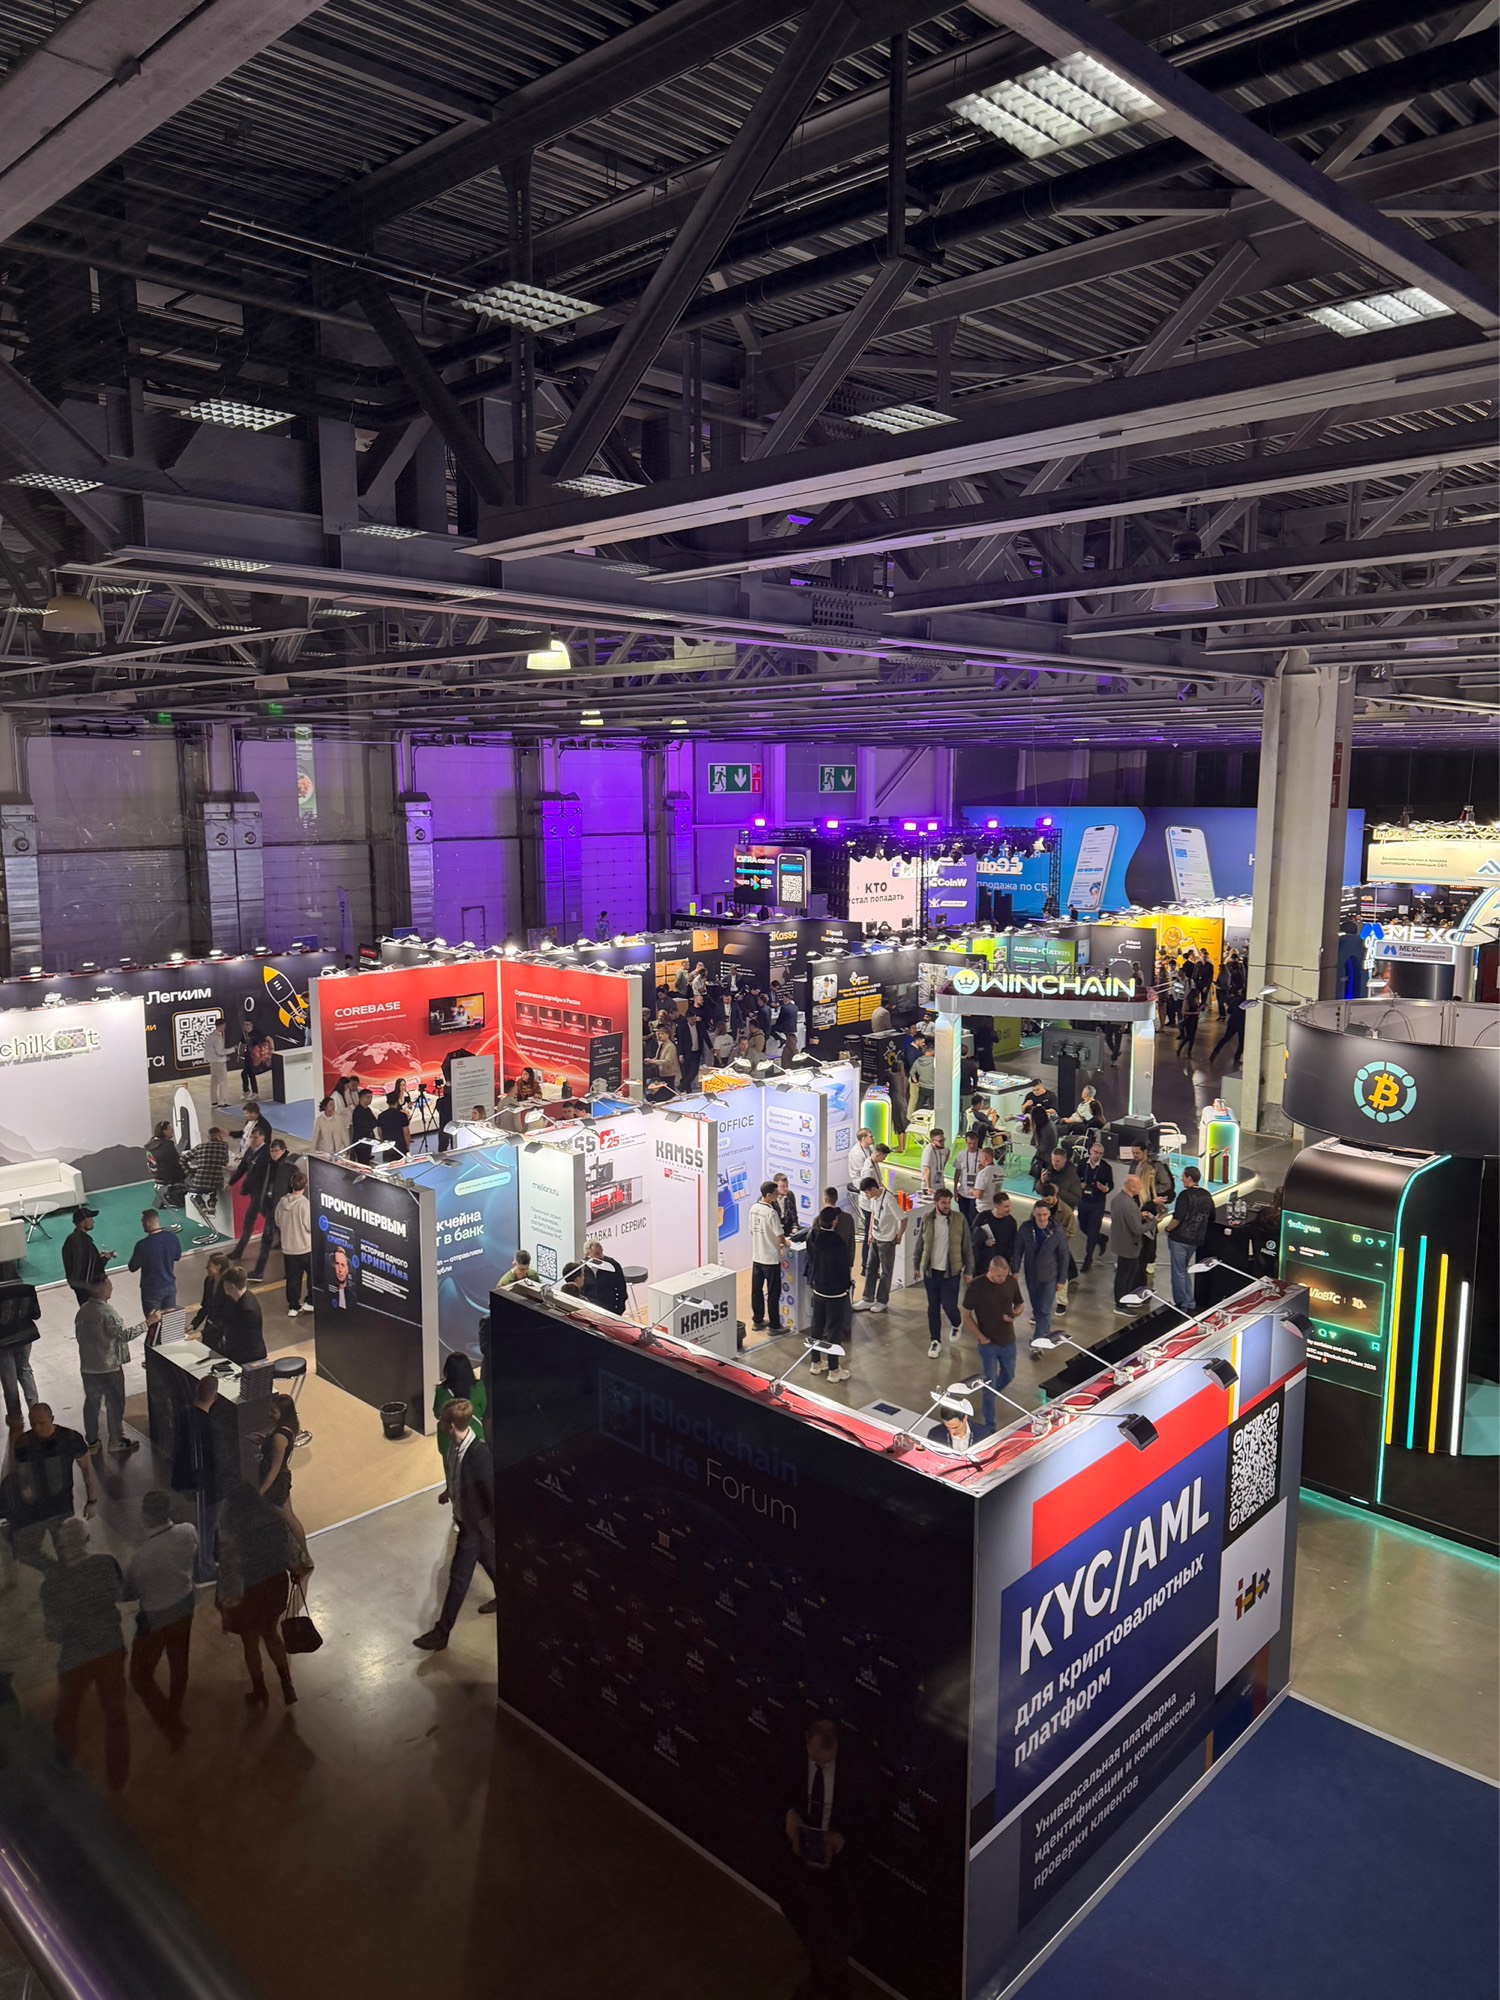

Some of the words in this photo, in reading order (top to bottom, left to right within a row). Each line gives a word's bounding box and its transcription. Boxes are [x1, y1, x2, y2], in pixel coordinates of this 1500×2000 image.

[865, 882, 887, 894] КТО
[1020, 883, 1032, 891] по
[1034, 882, 1049, 892] СБ
[870, 894, 904, 903] попадать
[1387, 924, 1461, 946] MEXC
[1399, 945, 1422, 953] MEXC
[146, 988, 212, 1005] Легким
[981, 973, 1136, 998] WINCHAIN
[334, 1001, 402, 1018] COREBASE
[719, 1114, 755, 1133] OFFICE
[606, 1135, 620, 1149] 25
[656, 1139, 704, 1169] KAMSS
[320, 1192, 361, 1220] ПРОЧТИ
[361, 1207, 407, 1238] ПЕРВЫМ
[621, 1216, 647, 1235] СЕРВИС
[443, 1233, 453, 1245] в
[453, 1224, 485, 1243] банк
[385, 1253, 409, 1269] ОДНОГО
[1309, 1287, 1341, 1305] ViaBTC
[680, 1300, 729, 1335] KAMSS
[650, 1392, 799, 1487] Blockchain
[650, 1432, 698, 1480] Life
[707, 1457, 797, 1530] Forum
[1019, 1476, 1210, 1675] KYC/AML
[1014, 1683, 1054, 1736] для
[1058, 1552, 1205, 1698] криптовалютных
[1013, 1666, 1112, 1768] платформ
[1034, 1742, 1121, 1838] Универсальная
[1121, 1691, 1178, 1753] платформа
[1033, 1764, 1122, 1866] идентификации
[1124, 1757, 1133, 1776] и
[1133, 1693, 1197, 1768] комплексной
[1033, 1826, 1090, 1890] проверки
[1090, 1772, 1140, 1830] клиентов
